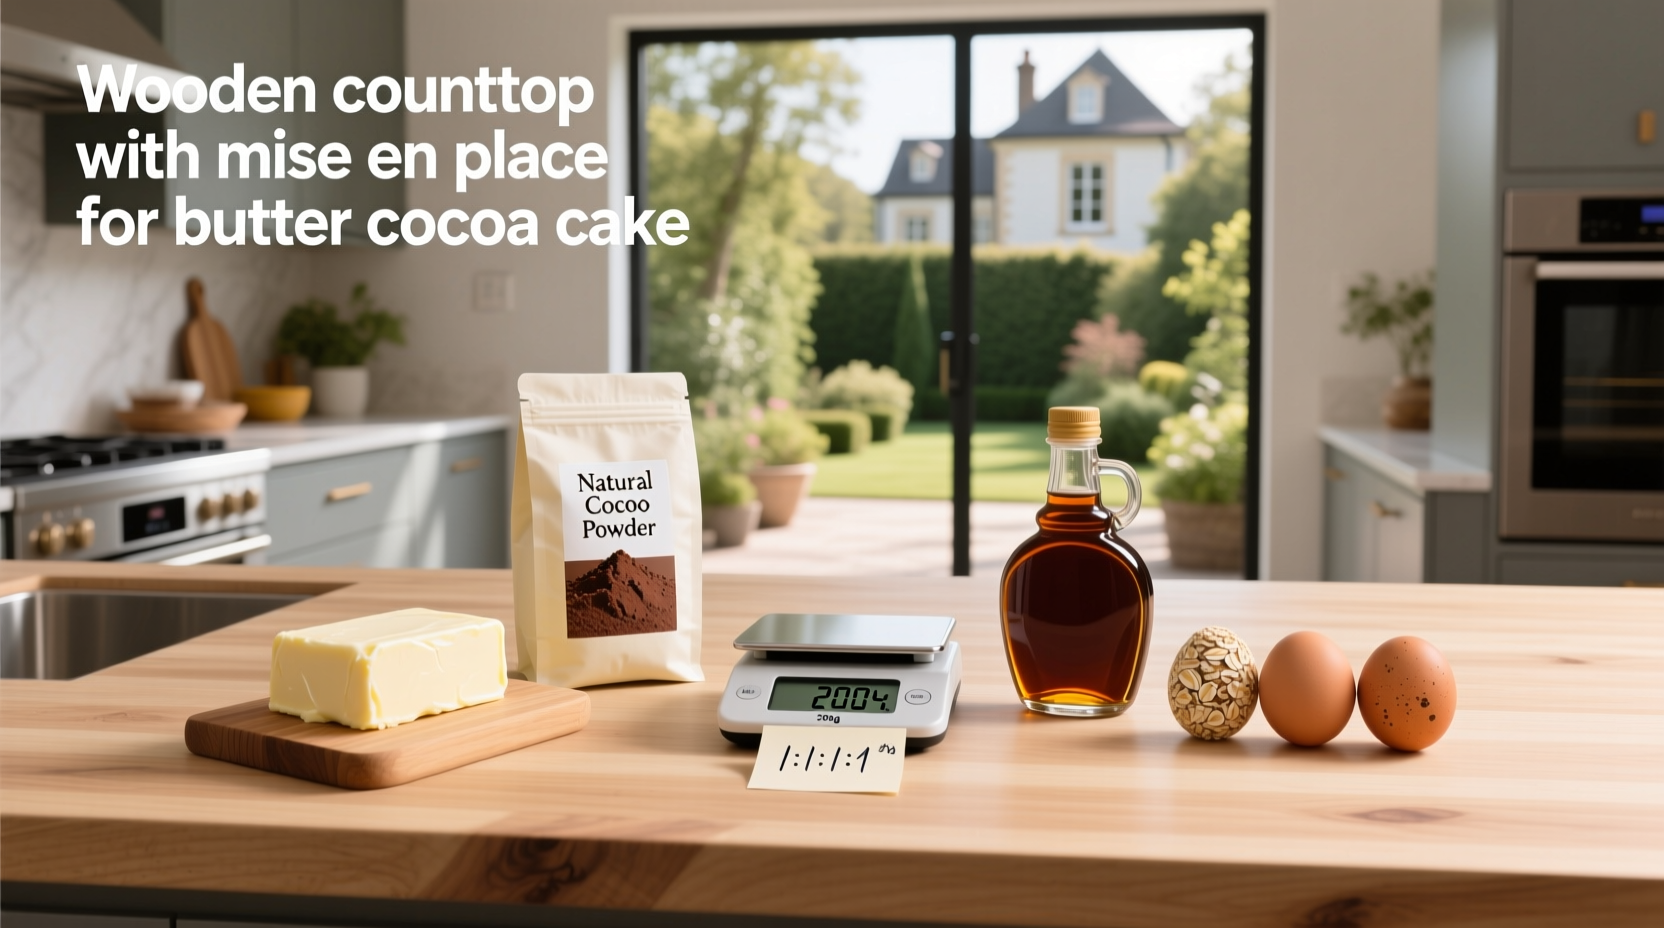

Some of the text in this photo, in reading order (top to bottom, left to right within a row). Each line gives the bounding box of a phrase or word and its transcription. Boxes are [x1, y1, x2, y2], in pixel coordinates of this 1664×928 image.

[577, 470, 653, 493] Natural
[585, 495, 650, 515] Cocoo
[582, 517, 657, 539] Powder
